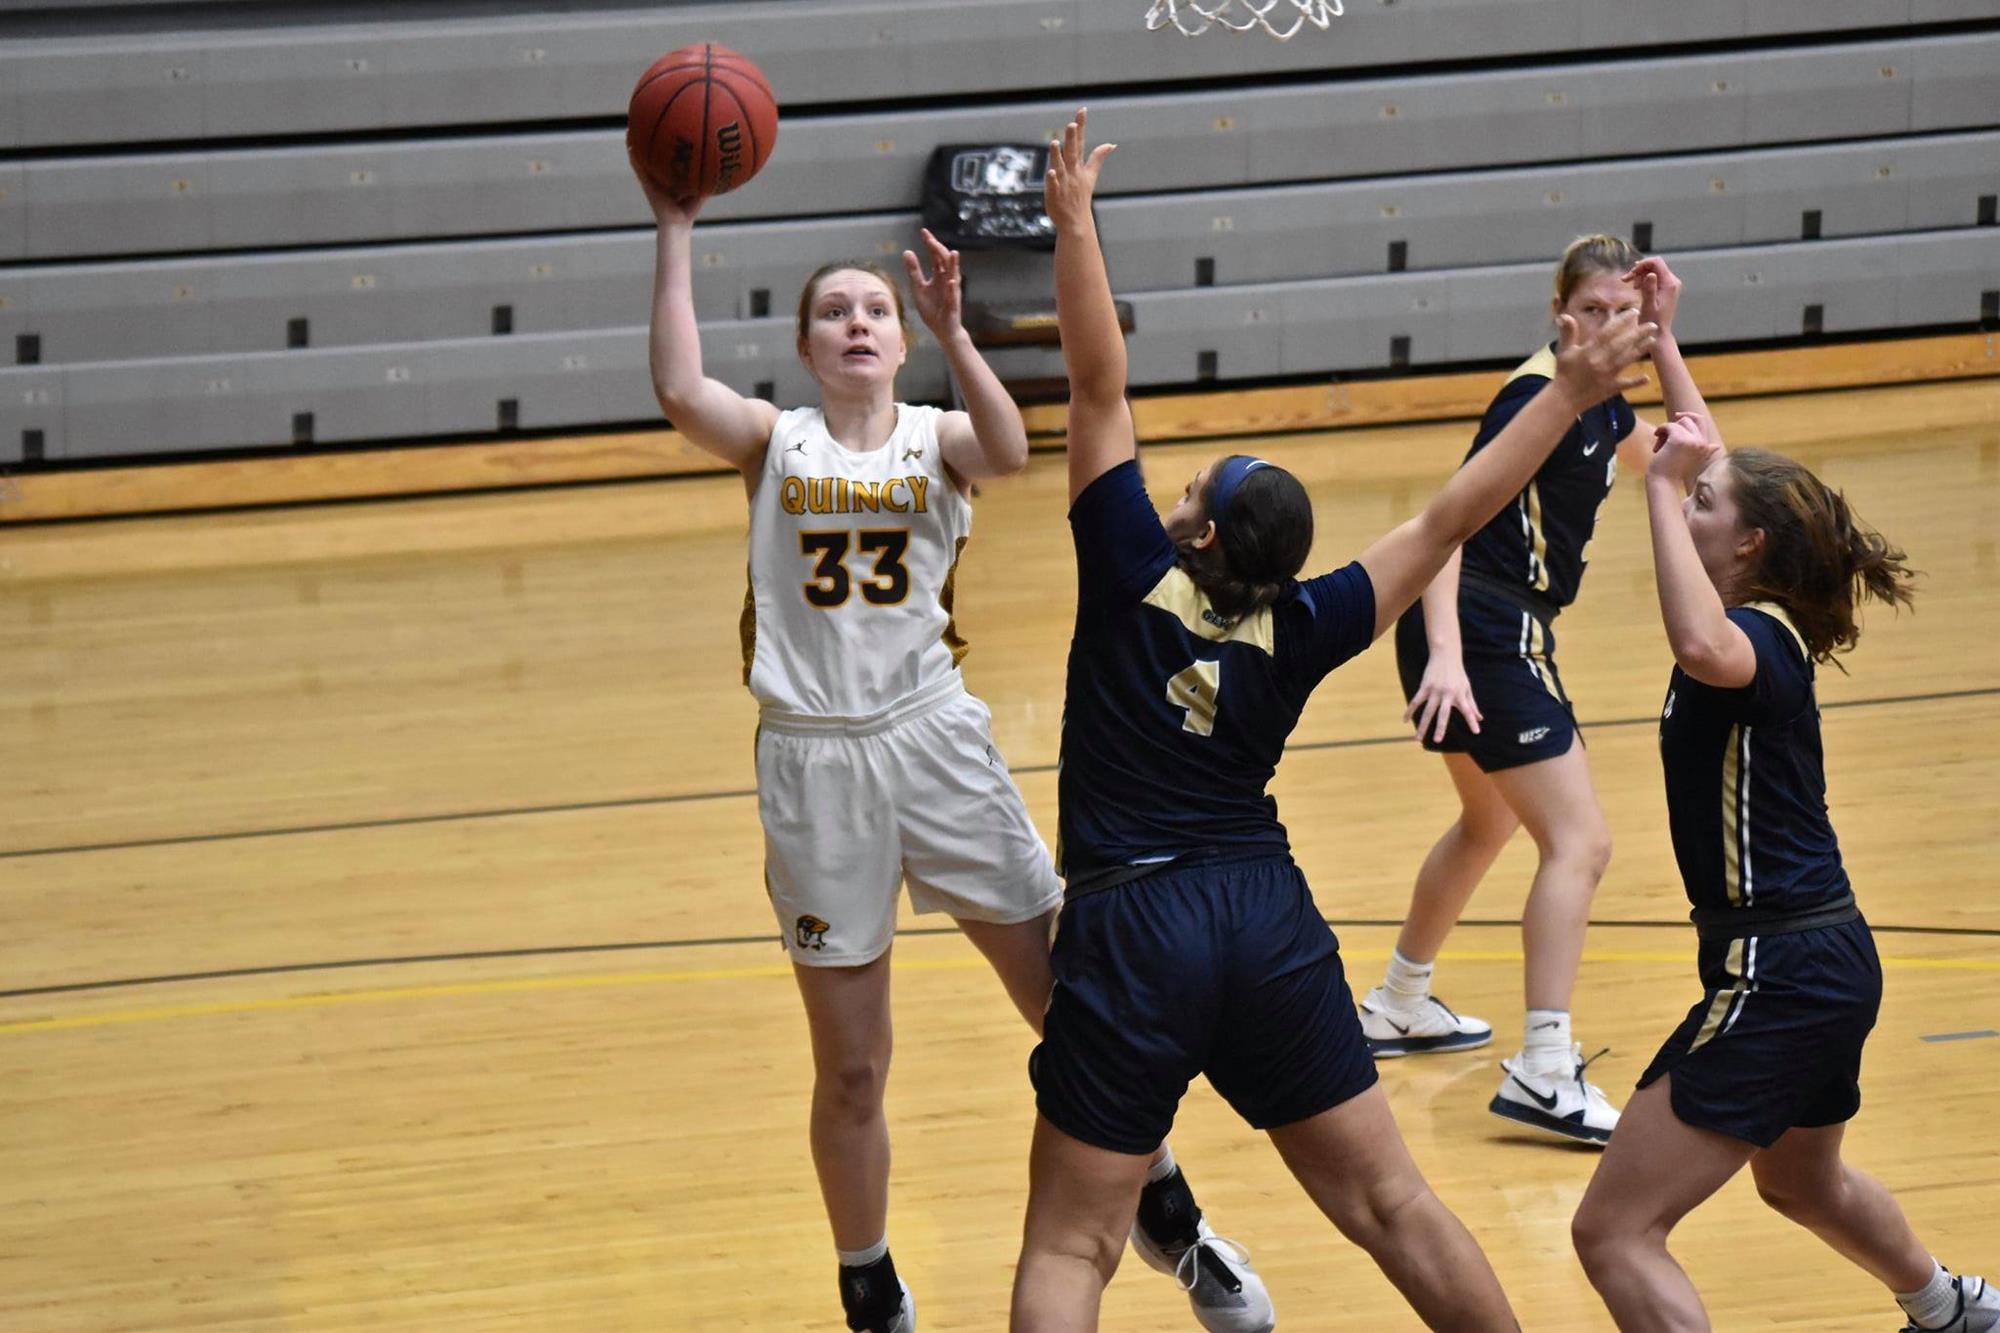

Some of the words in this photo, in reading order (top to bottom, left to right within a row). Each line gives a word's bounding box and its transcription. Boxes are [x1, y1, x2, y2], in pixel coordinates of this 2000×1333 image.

[717, 120, 742, 193] Wil
[780, 475, 929, 515] QUINCY
[799, 527, 911, 609] 33
[1166, 659, 1220, 737] 4
